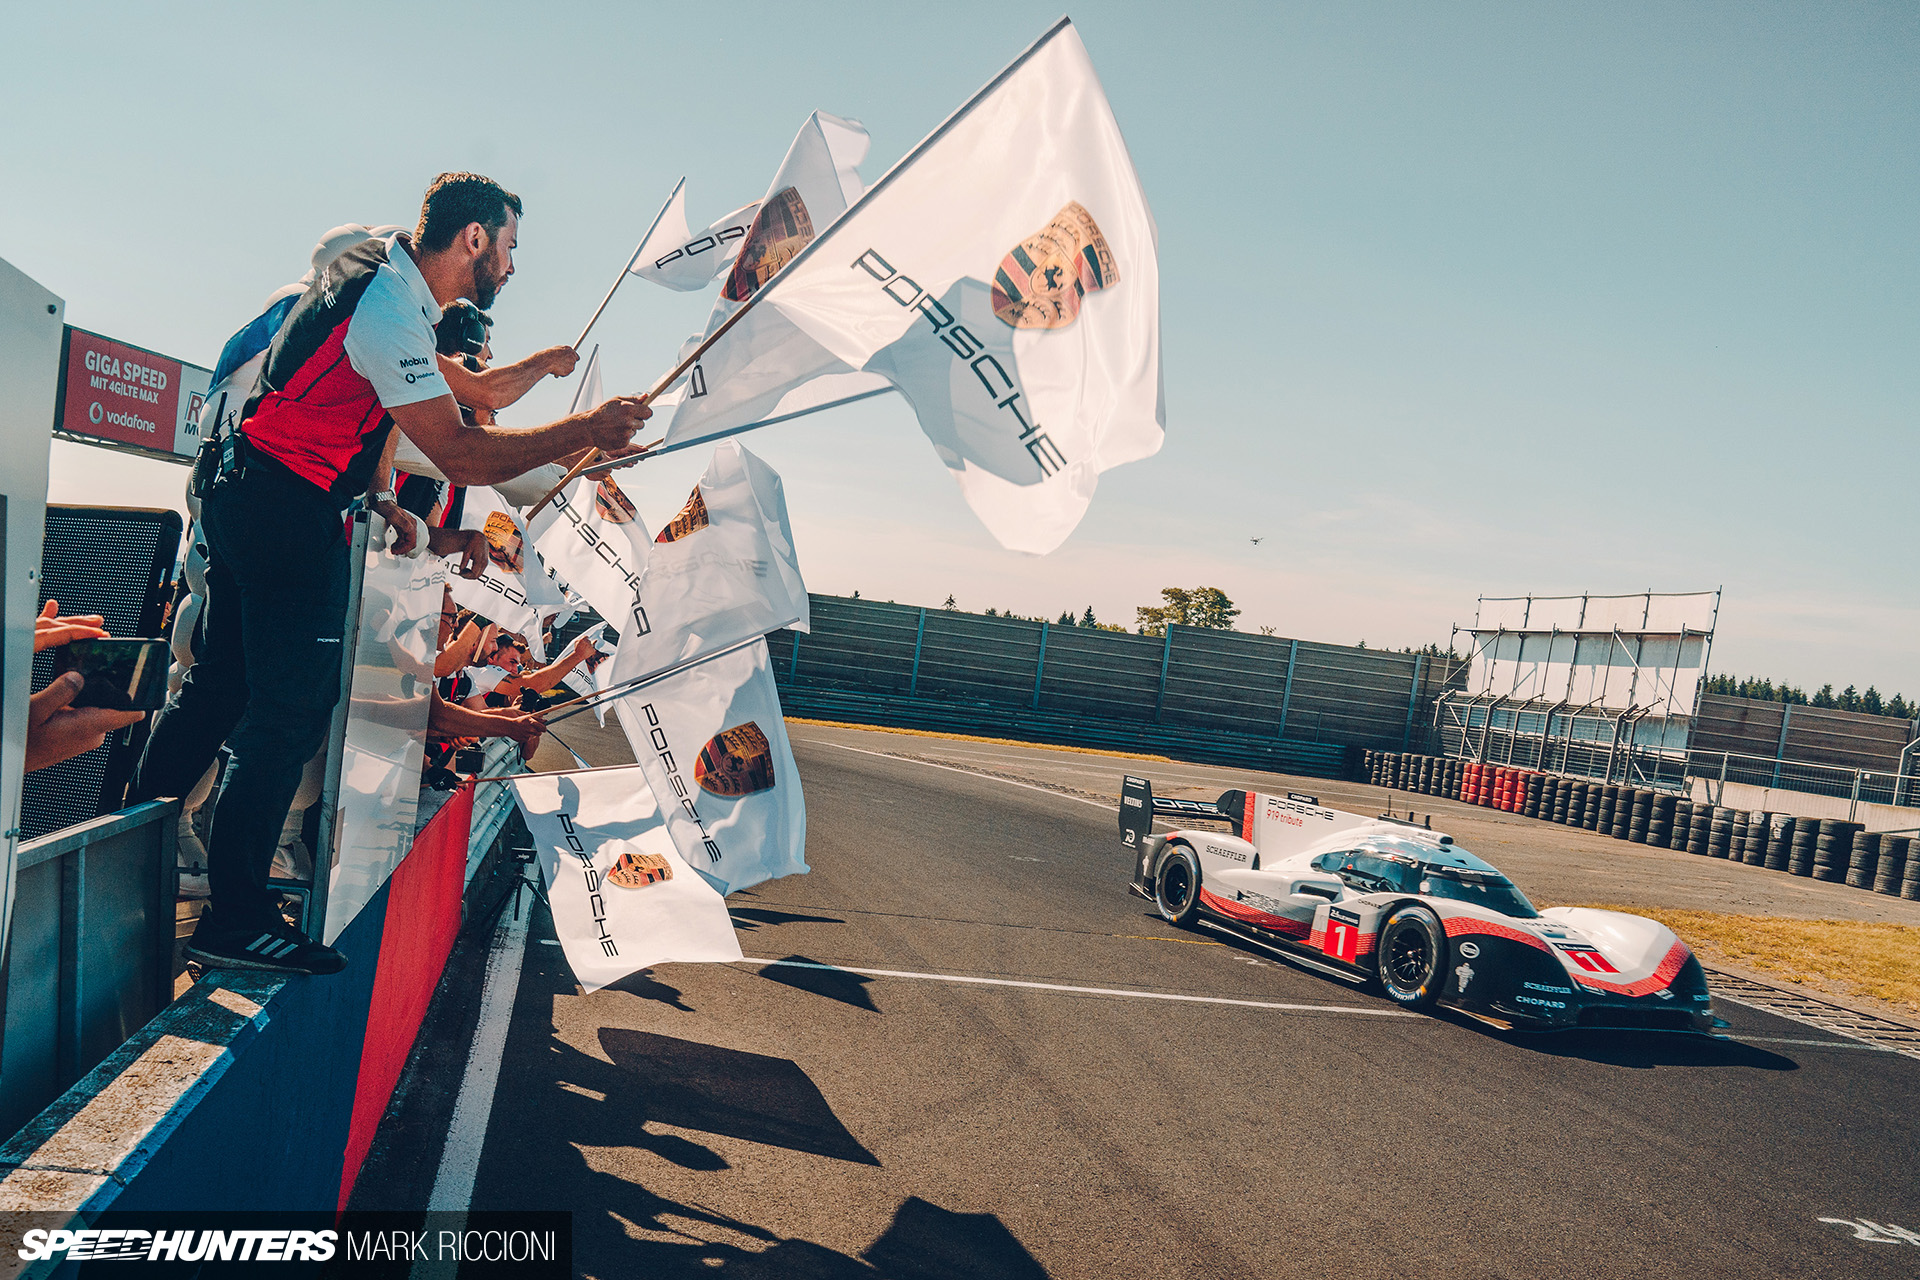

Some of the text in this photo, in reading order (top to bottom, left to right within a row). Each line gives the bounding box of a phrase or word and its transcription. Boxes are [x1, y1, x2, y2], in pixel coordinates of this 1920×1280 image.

[84, 350, 168, 390] GIGA SPEED
[850, 248, 1068, 478] PORSCHE
[90, 375, 108, 391] MIT
[139, 388, 159, 404] MAX
[106, 410, 156, 433] vodafone
[551, 490, 641, 592] ORSCHE
[641, 703, 722, 864] PORSCHE
[1266, 808, 1304, 828] 919 tribute
[1267, 798, 1335, 821] PORSCHE
[1206, 844, 1248, 863] SCHAEFFLER
[556, 813, 620, 958] PORSCHE
[1334, 925, 1347, 957] 1
[1574, 951, 1607, 973] 1
[1515, 995, 1566, 1009] CHOPARD
